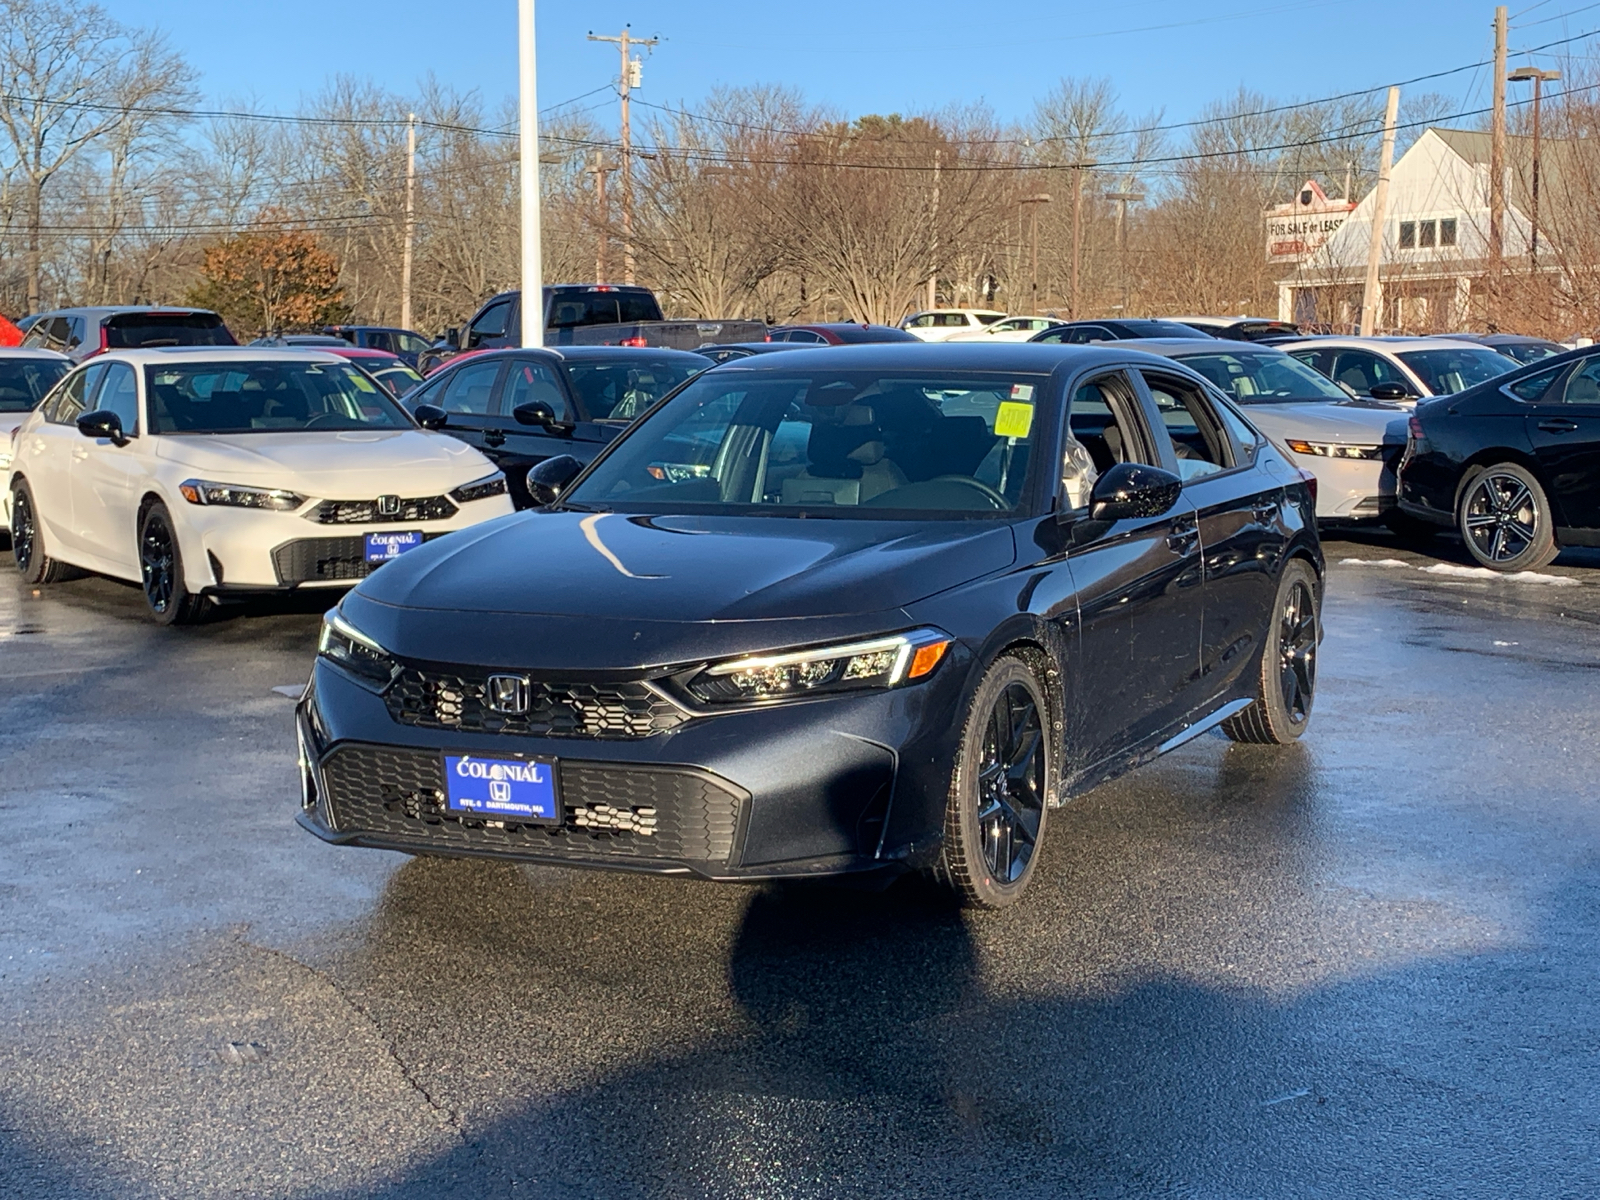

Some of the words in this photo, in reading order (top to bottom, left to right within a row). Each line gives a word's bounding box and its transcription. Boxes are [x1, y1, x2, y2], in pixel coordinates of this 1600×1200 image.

[1271, 223, 1285, 235] FOR
[1287, 222, 1307, 234] SALE
[370, 534, 416, 545] COLONIAL
[456, 762, 543, 783] COLONIAL
[486, 801, 532, 813] DARTMOUTH,
[533, 805, 544, 813] MA
